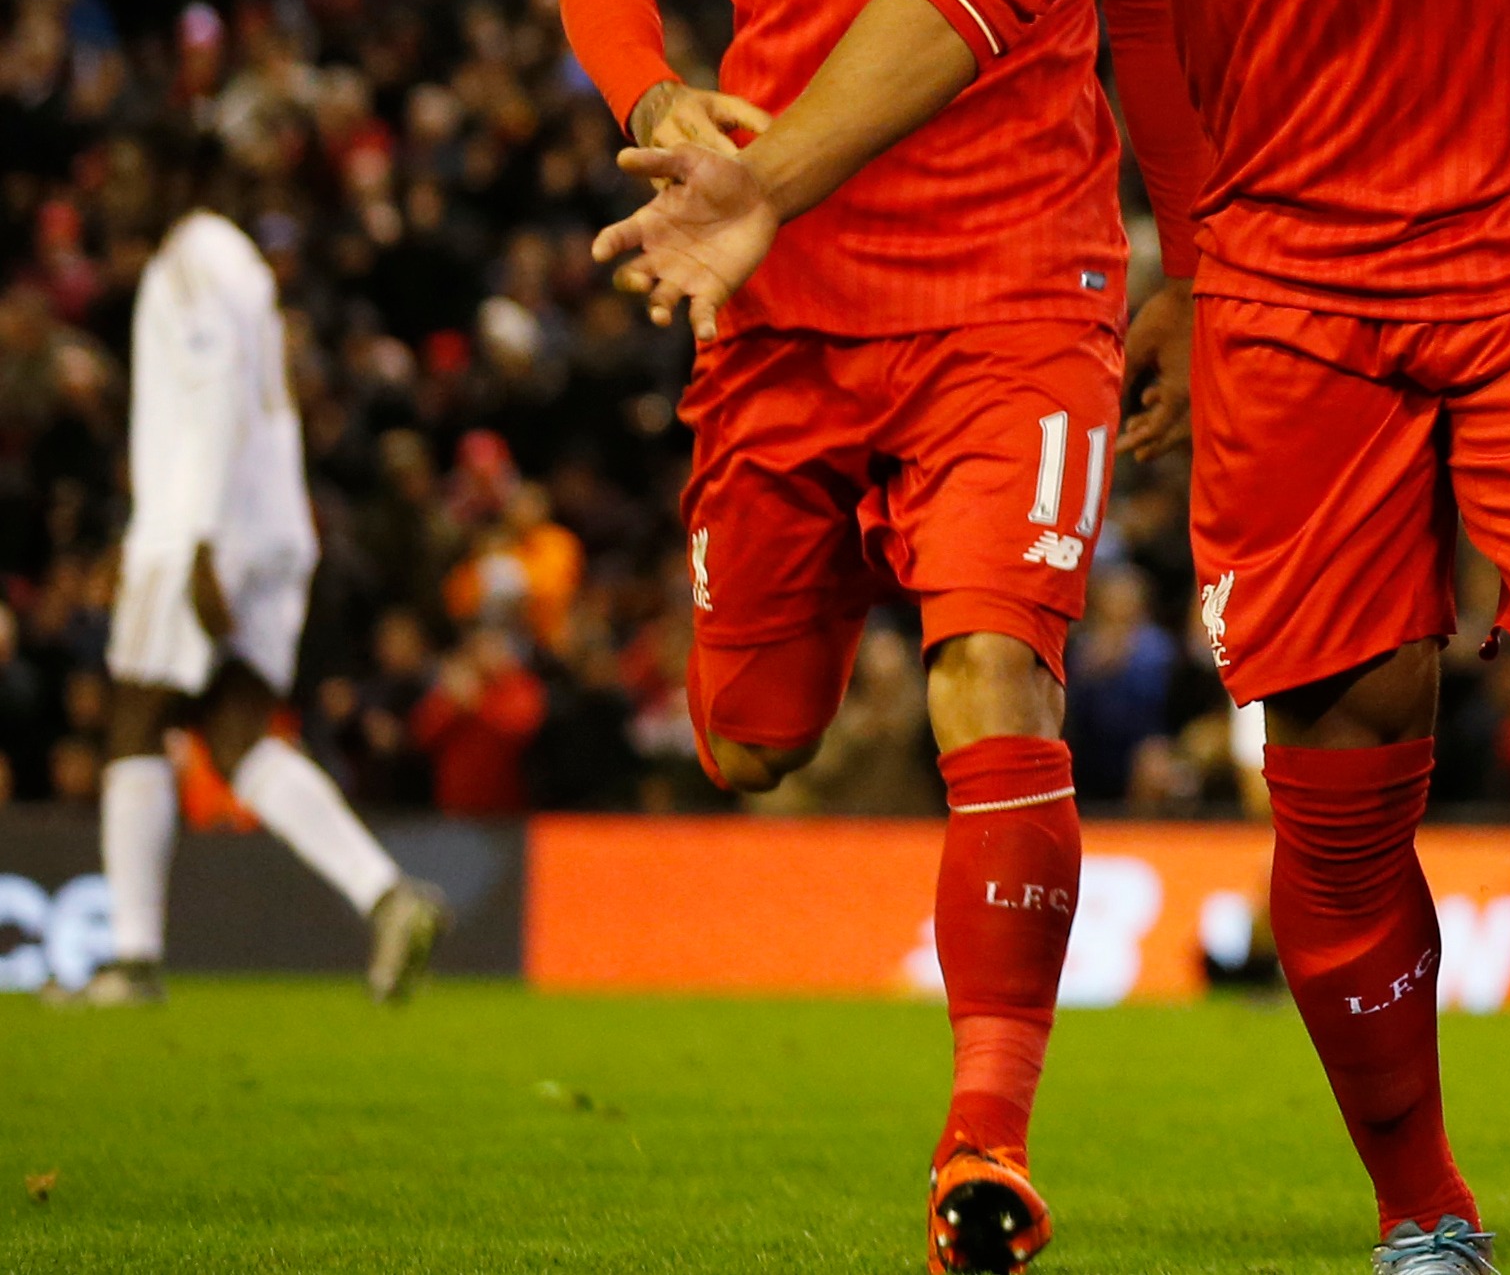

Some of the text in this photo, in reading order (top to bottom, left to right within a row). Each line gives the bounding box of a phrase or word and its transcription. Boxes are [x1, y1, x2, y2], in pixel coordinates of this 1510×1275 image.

[1027, 410, 1108, 539] 11
[1022, 530, 1084, 571] NB
[905, 854, 1164, 1010] B
